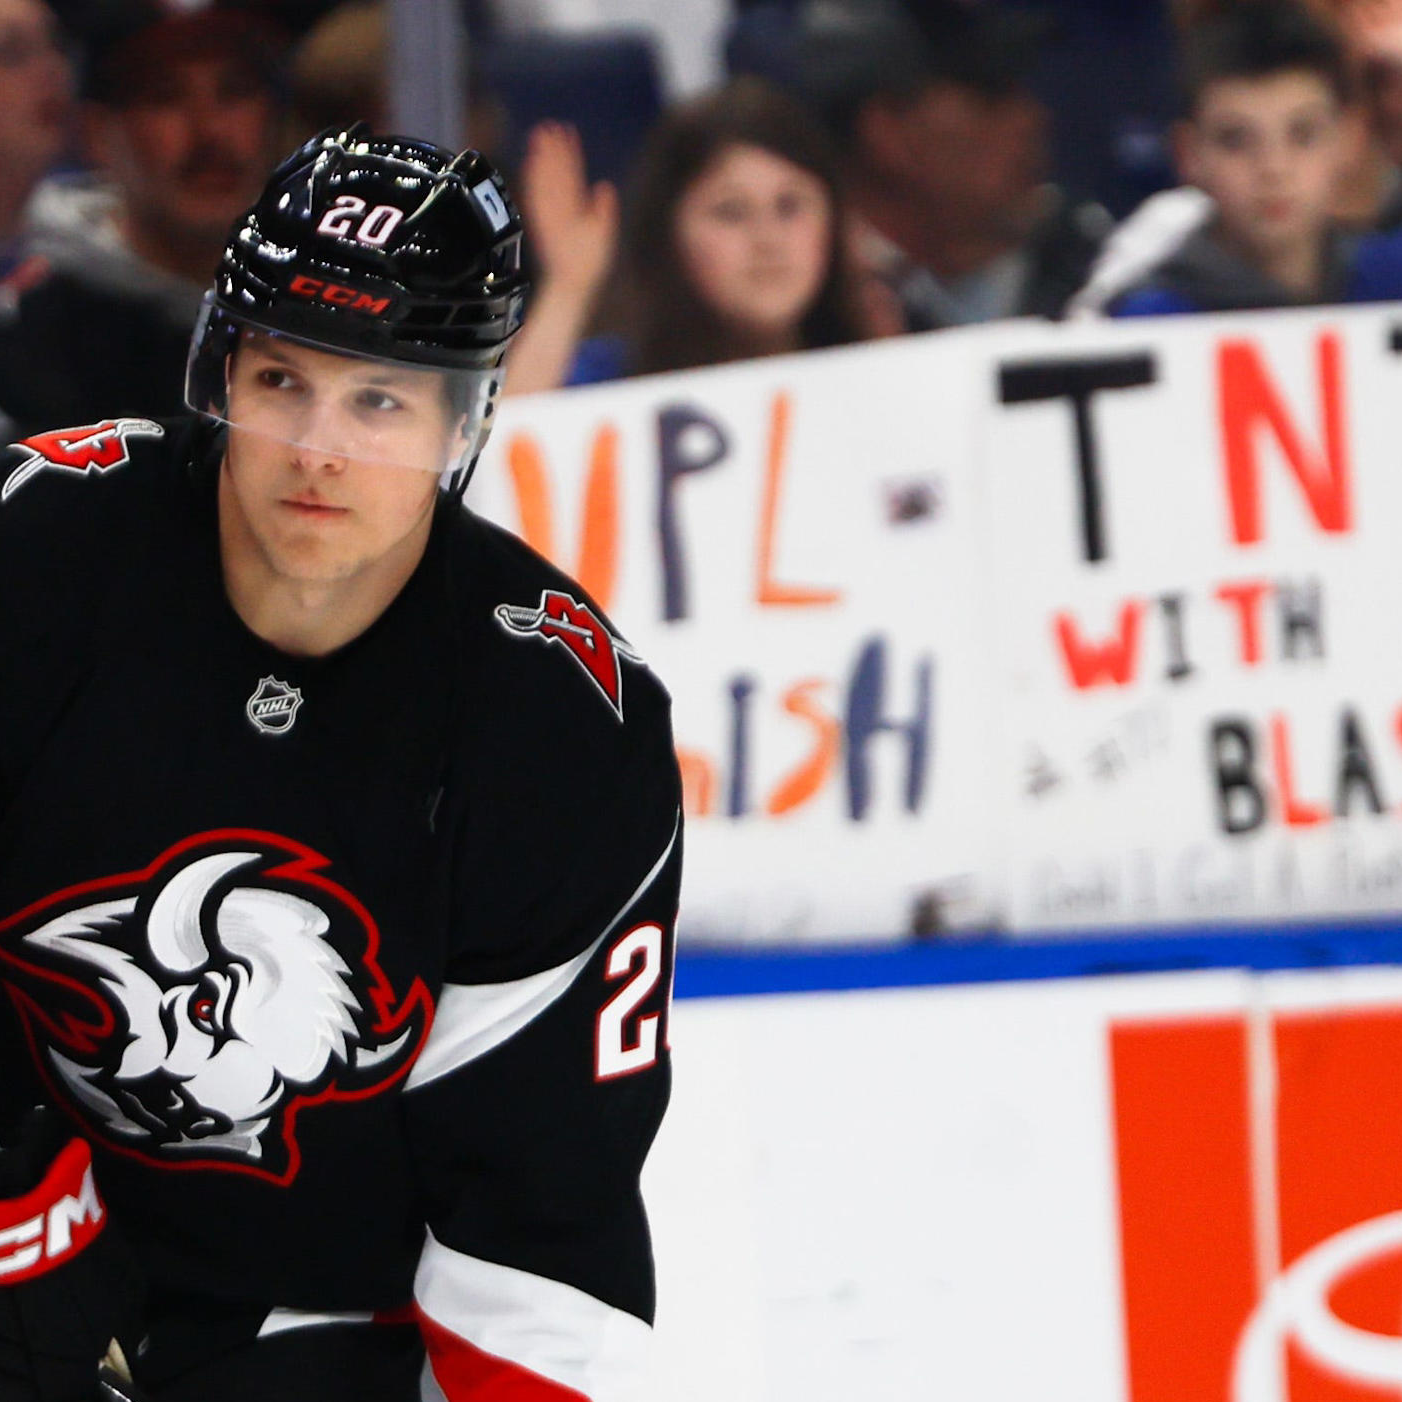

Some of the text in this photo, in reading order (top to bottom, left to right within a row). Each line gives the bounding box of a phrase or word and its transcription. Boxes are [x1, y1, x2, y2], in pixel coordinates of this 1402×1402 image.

[316, 194, 404, 247] 20
[289, 273, 392, 317] CCM
[1053, 572, 1326, 690] WITH
[255, 697, 291, 715] NHL
[594, 918, 680, 1083] 2
